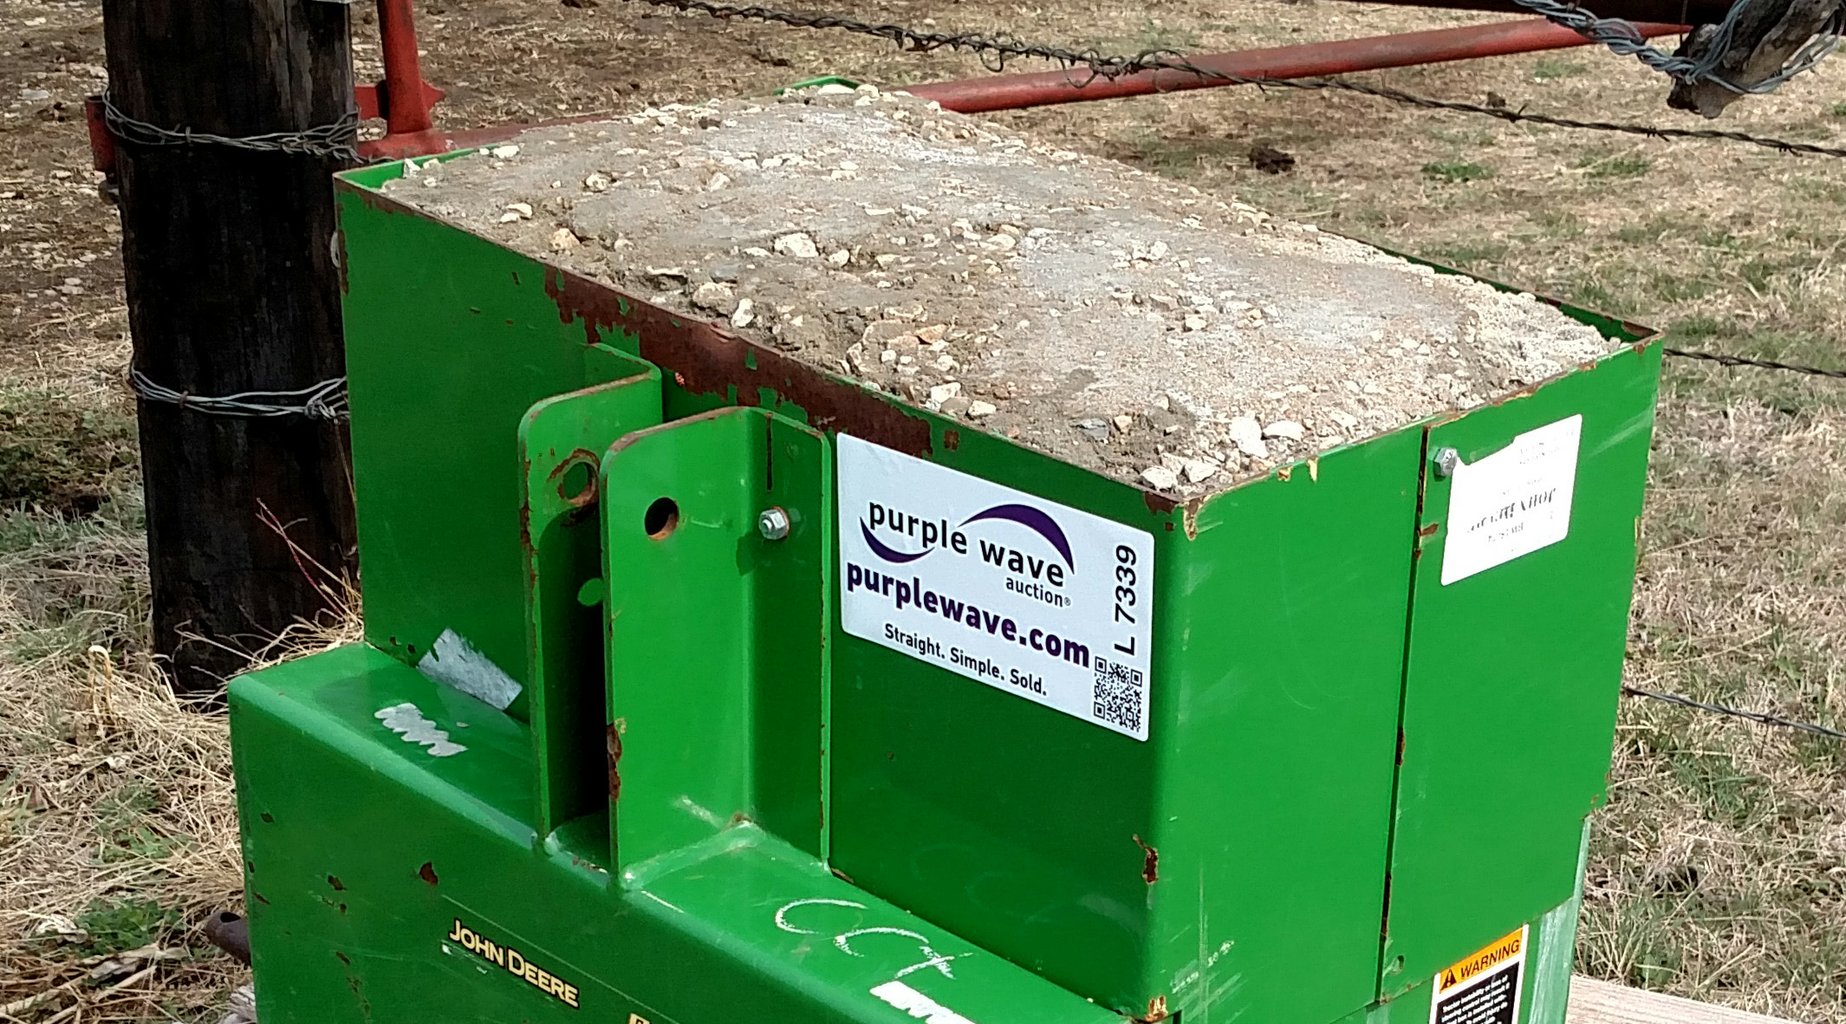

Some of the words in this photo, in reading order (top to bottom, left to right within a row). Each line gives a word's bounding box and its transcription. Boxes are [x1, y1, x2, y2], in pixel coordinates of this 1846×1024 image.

[869, 501, 967, 554] purple
[979, 539, 1064, 587] wave
[1114, 544, 1137, 625] 7339
[846, 561, 1090, 668] purplewave.com
[1113, 636, 1136, 656] L
[884, 623, 945, 659] Straight.
[949, 647, 1005, 680] Simple.
[1009, 668, 1047, 696] Sold.
[449, 919, 504, 967] JOHN
[507, 948, 579, 1008] DEERE
[1460, 939, 1520, 979] WARNING
